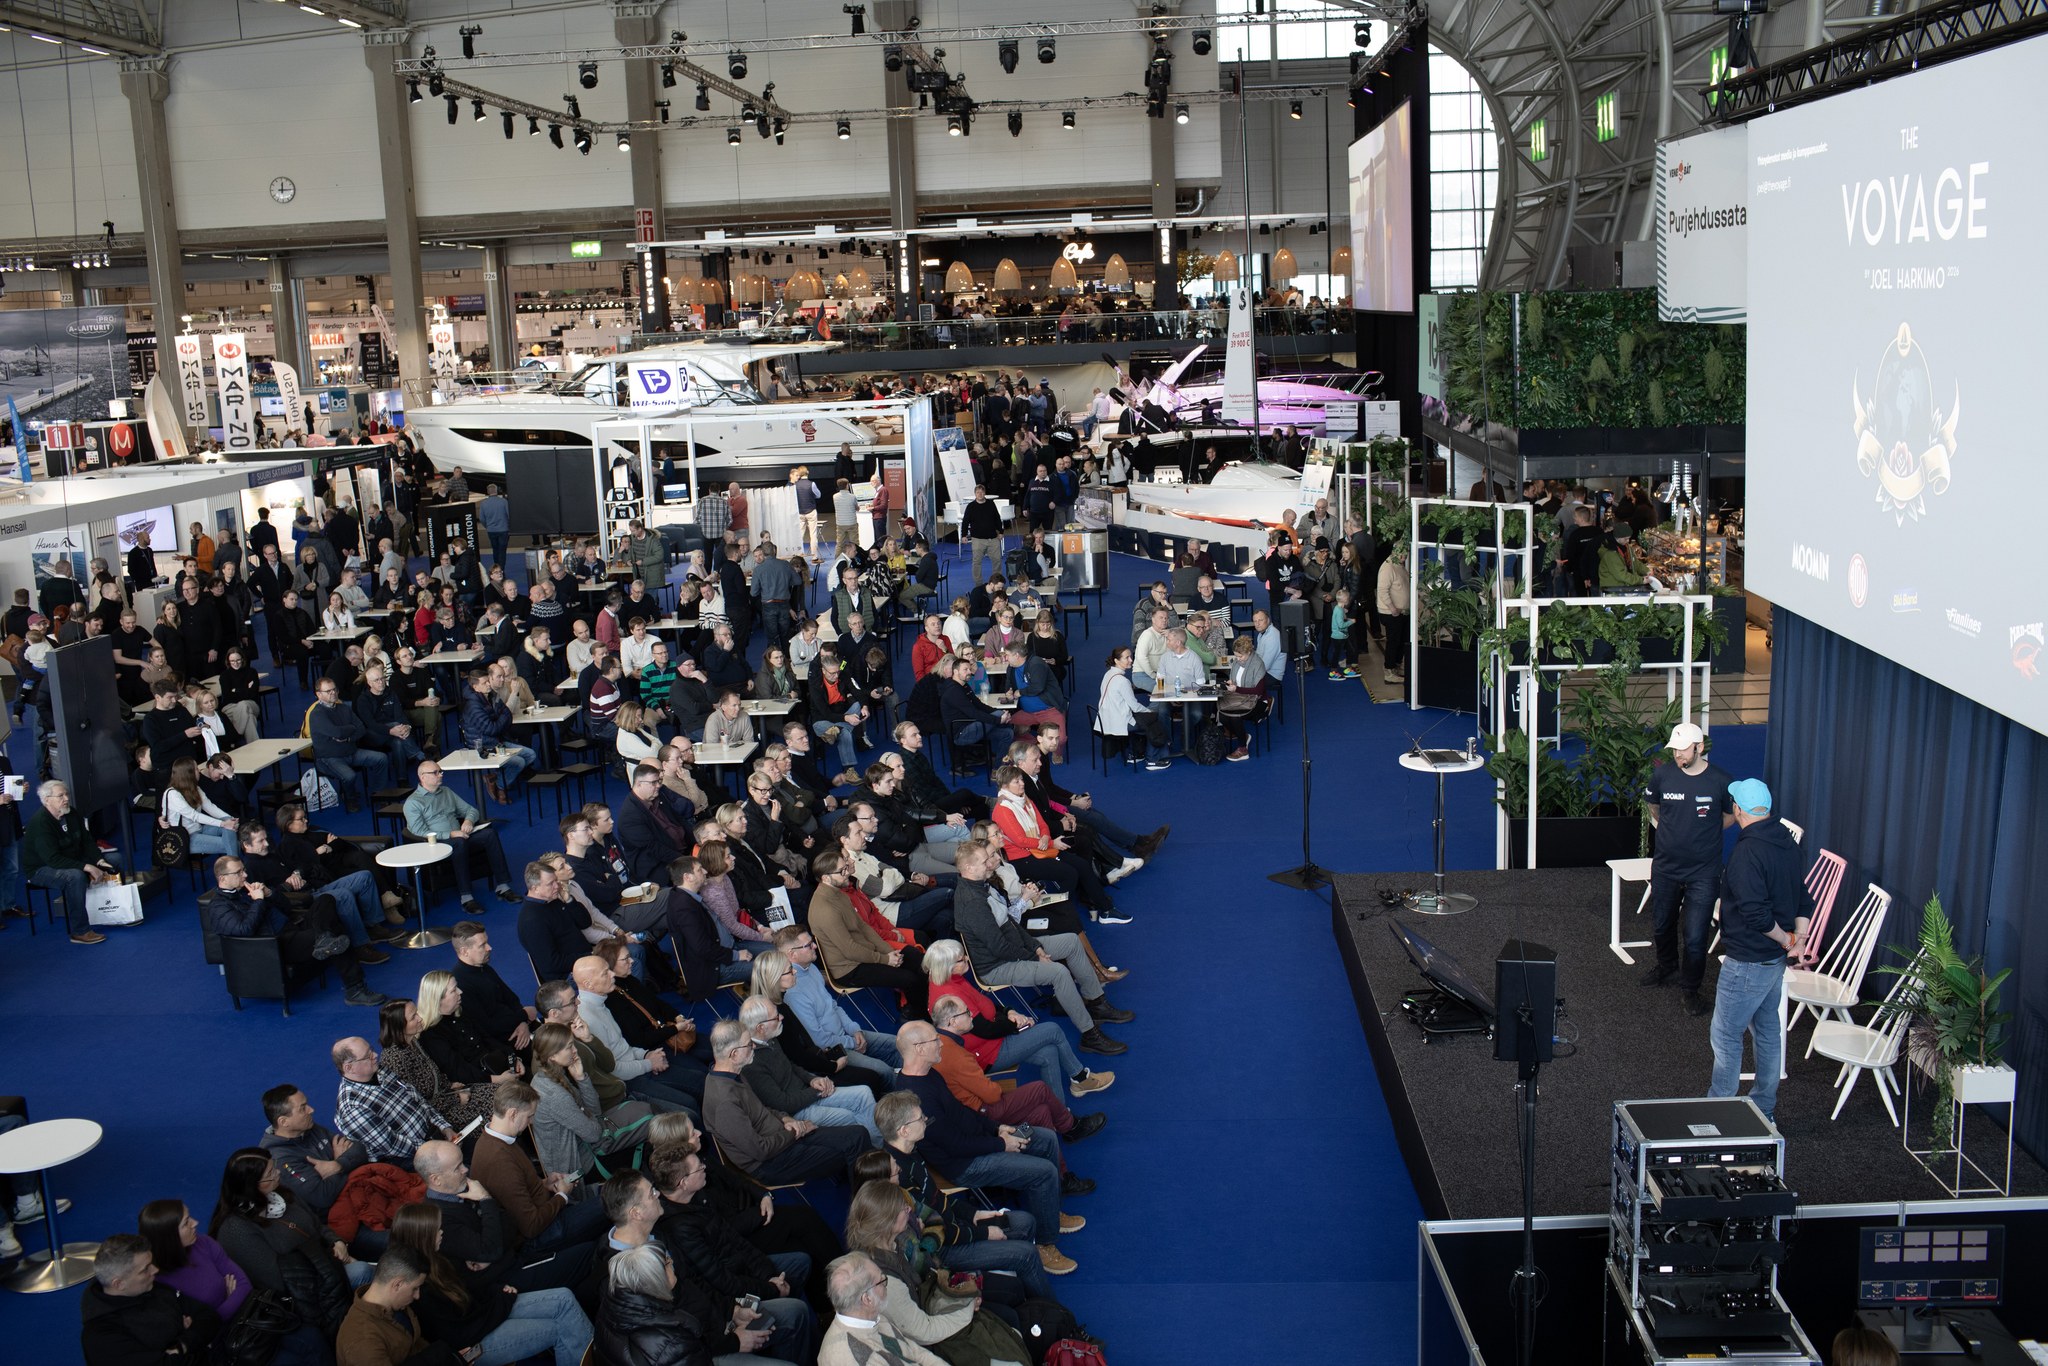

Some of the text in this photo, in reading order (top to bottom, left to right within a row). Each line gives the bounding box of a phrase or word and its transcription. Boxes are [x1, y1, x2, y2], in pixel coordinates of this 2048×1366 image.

[1900, 126, 1919, 151] THE
[1841, 161, 1989, 247] VOYAGE
[1158, 220, 1171, 228] 733
[1669, 204, 1747, 238] Purjehdussata
[644, 252, 655, 314] ROOFTOP
[1870, 268, 1892, 290] JOEL
[1897, 266, 1945, 289] HARKIMO
[69, 324, 110, 333] A-LAITURIT
[221, 367, 251, 448] MARINO
[331, 397, 347, 409] ba
[0, 520, 27, 536] Hansail
[427, 517, 436, 558] INFORMATION
[35, 537, 59, 550] Hanse
[1792, 540, 1830, 583] MOOMIN
